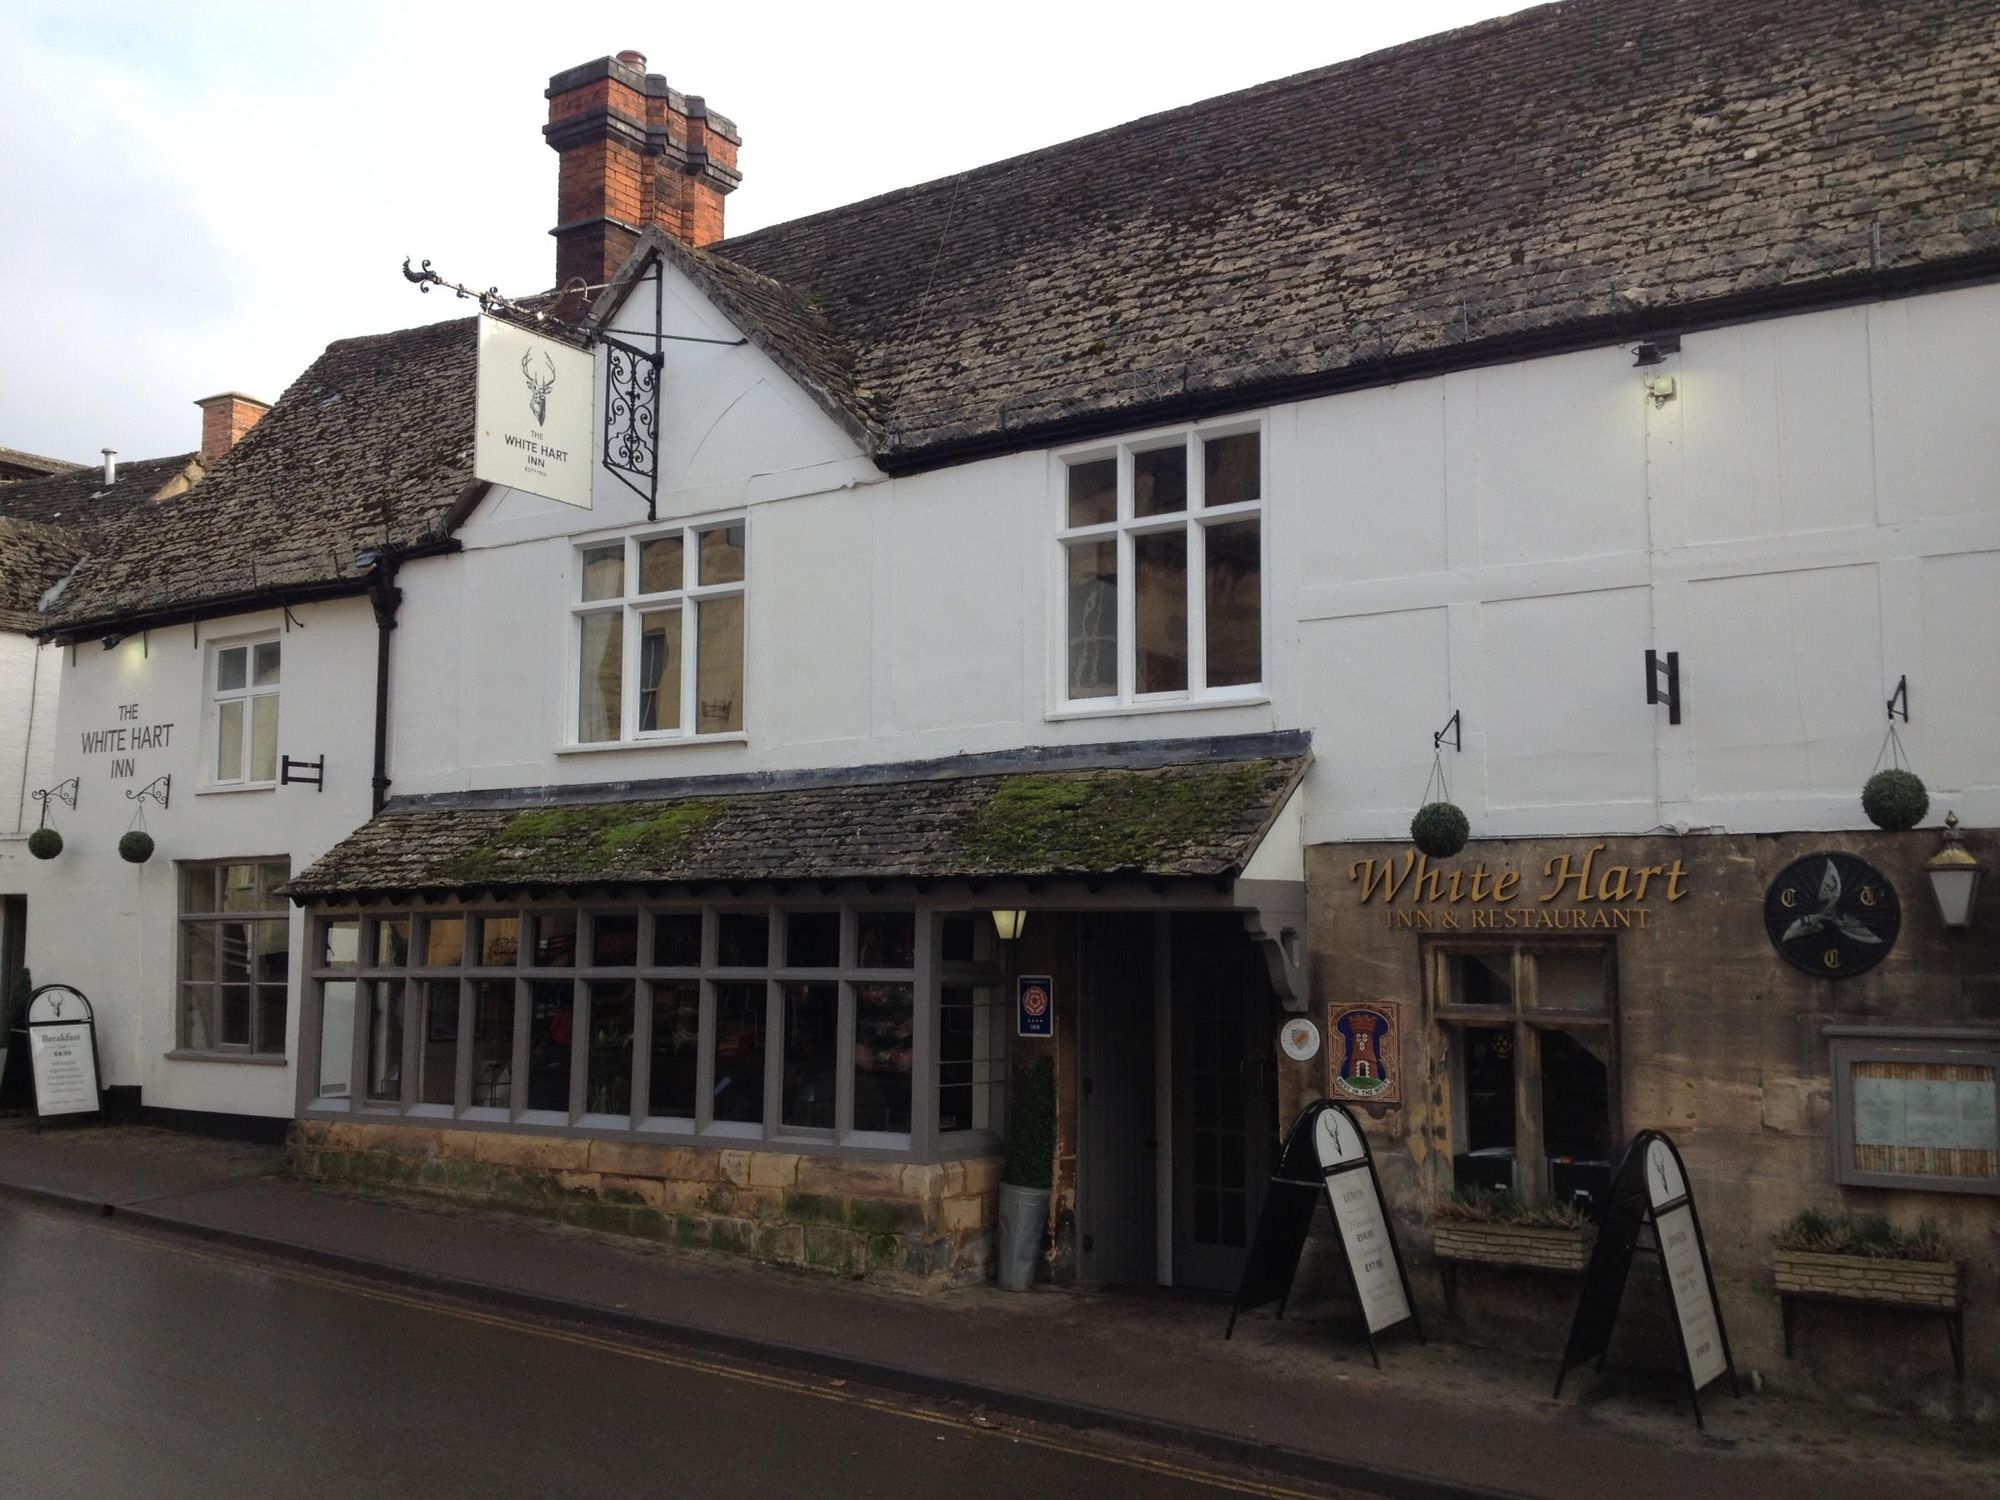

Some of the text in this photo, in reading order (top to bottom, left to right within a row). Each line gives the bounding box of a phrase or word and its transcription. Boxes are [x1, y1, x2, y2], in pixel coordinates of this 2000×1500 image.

[531, 430, 544, 441] THE
[504, 434, 568, 463] WHITE HART
[528, 455, 545, 468] INN
[118, 703, 139, 721] THE
[81, 723, 174, 754] WHITE HART
[110, 758, 135, 779] INN
[1350, 844, 1690, 903] White Hart
[1386, 907, 1652, 930] INN & RESTAURANT
[41, 1032, 80, 1043] Breakfast
